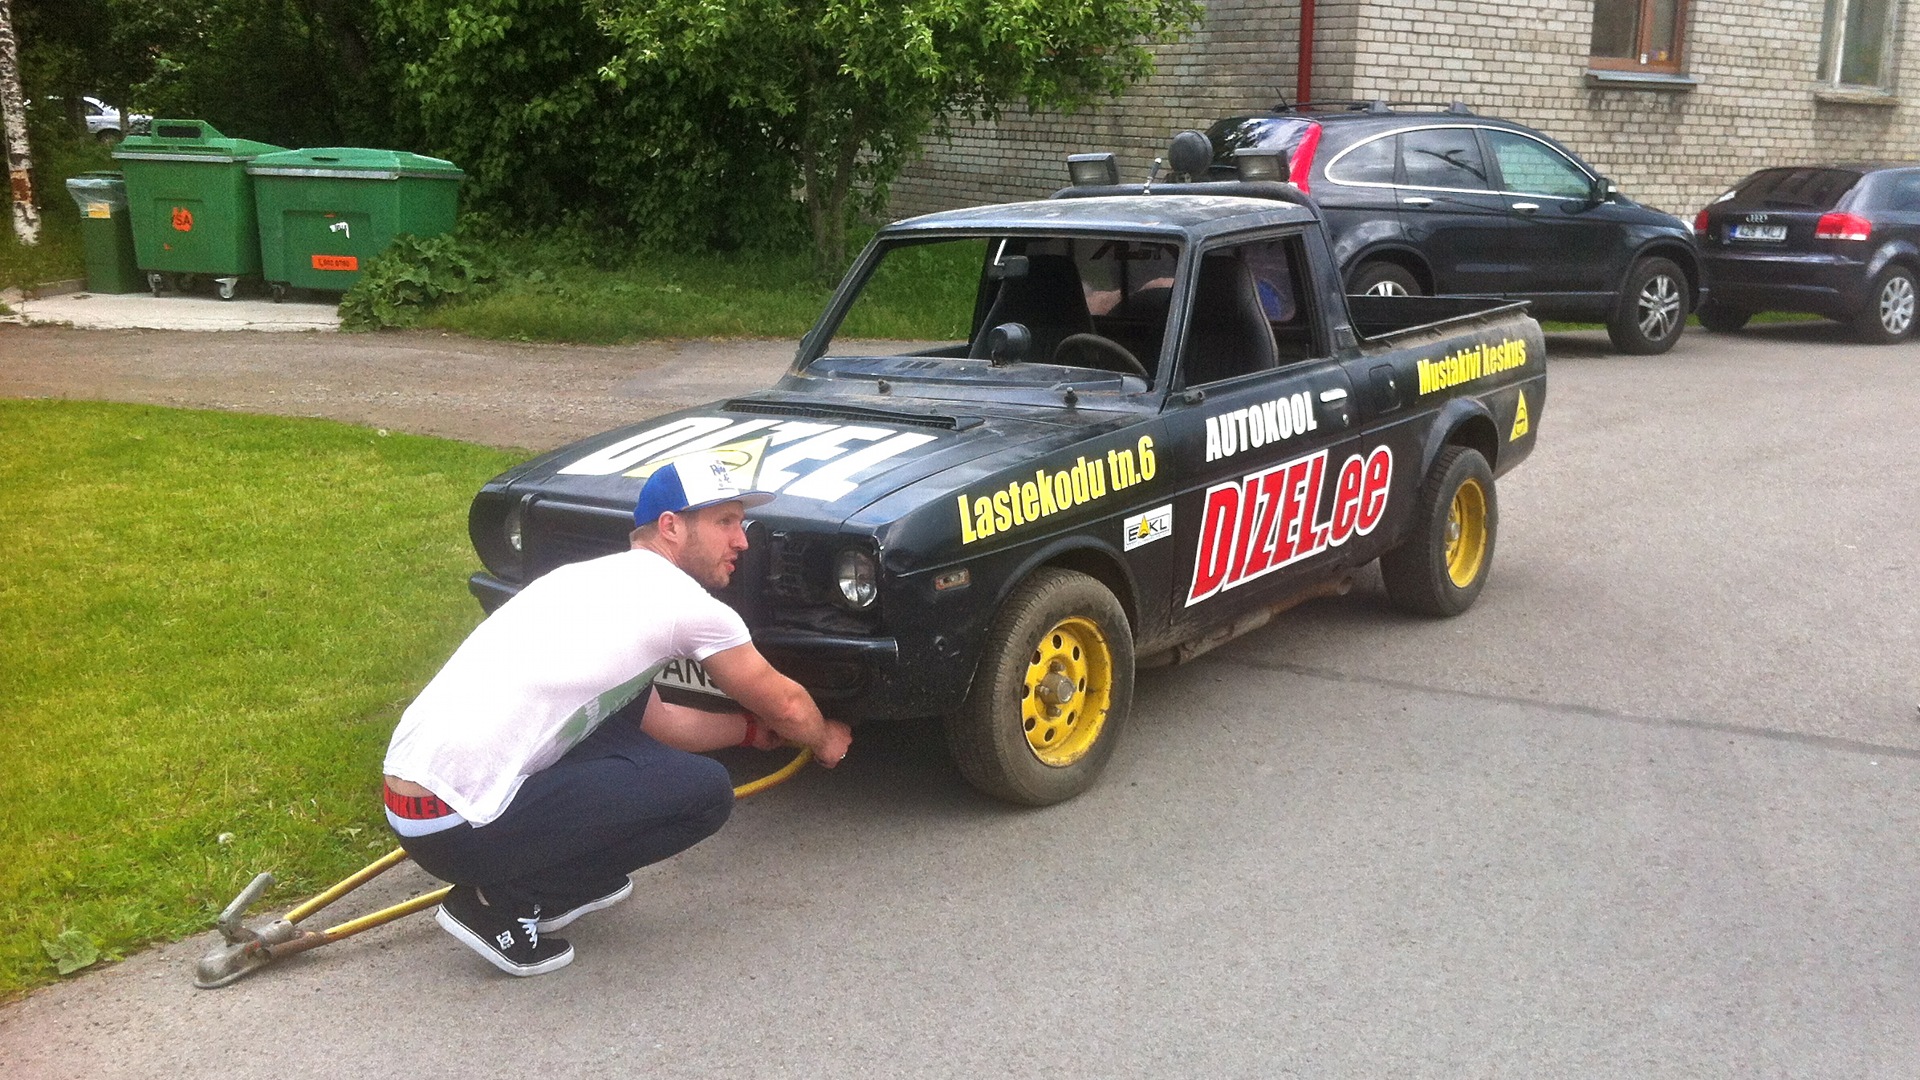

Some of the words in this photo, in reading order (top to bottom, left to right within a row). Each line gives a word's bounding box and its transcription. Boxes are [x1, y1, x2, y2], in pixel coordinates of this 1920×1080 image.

[1417, 345, 1481, 395] Mustakivi
[1482, 338, 1526, 376] keskus
[1206, 391, 1317, 462] AUTOKOOL
[957, 456, 1106, 544] Lastekodu
[1108, 435, 1156, 491] tn.6
[1184, 445, 1393, 608] DIZEL.ee
